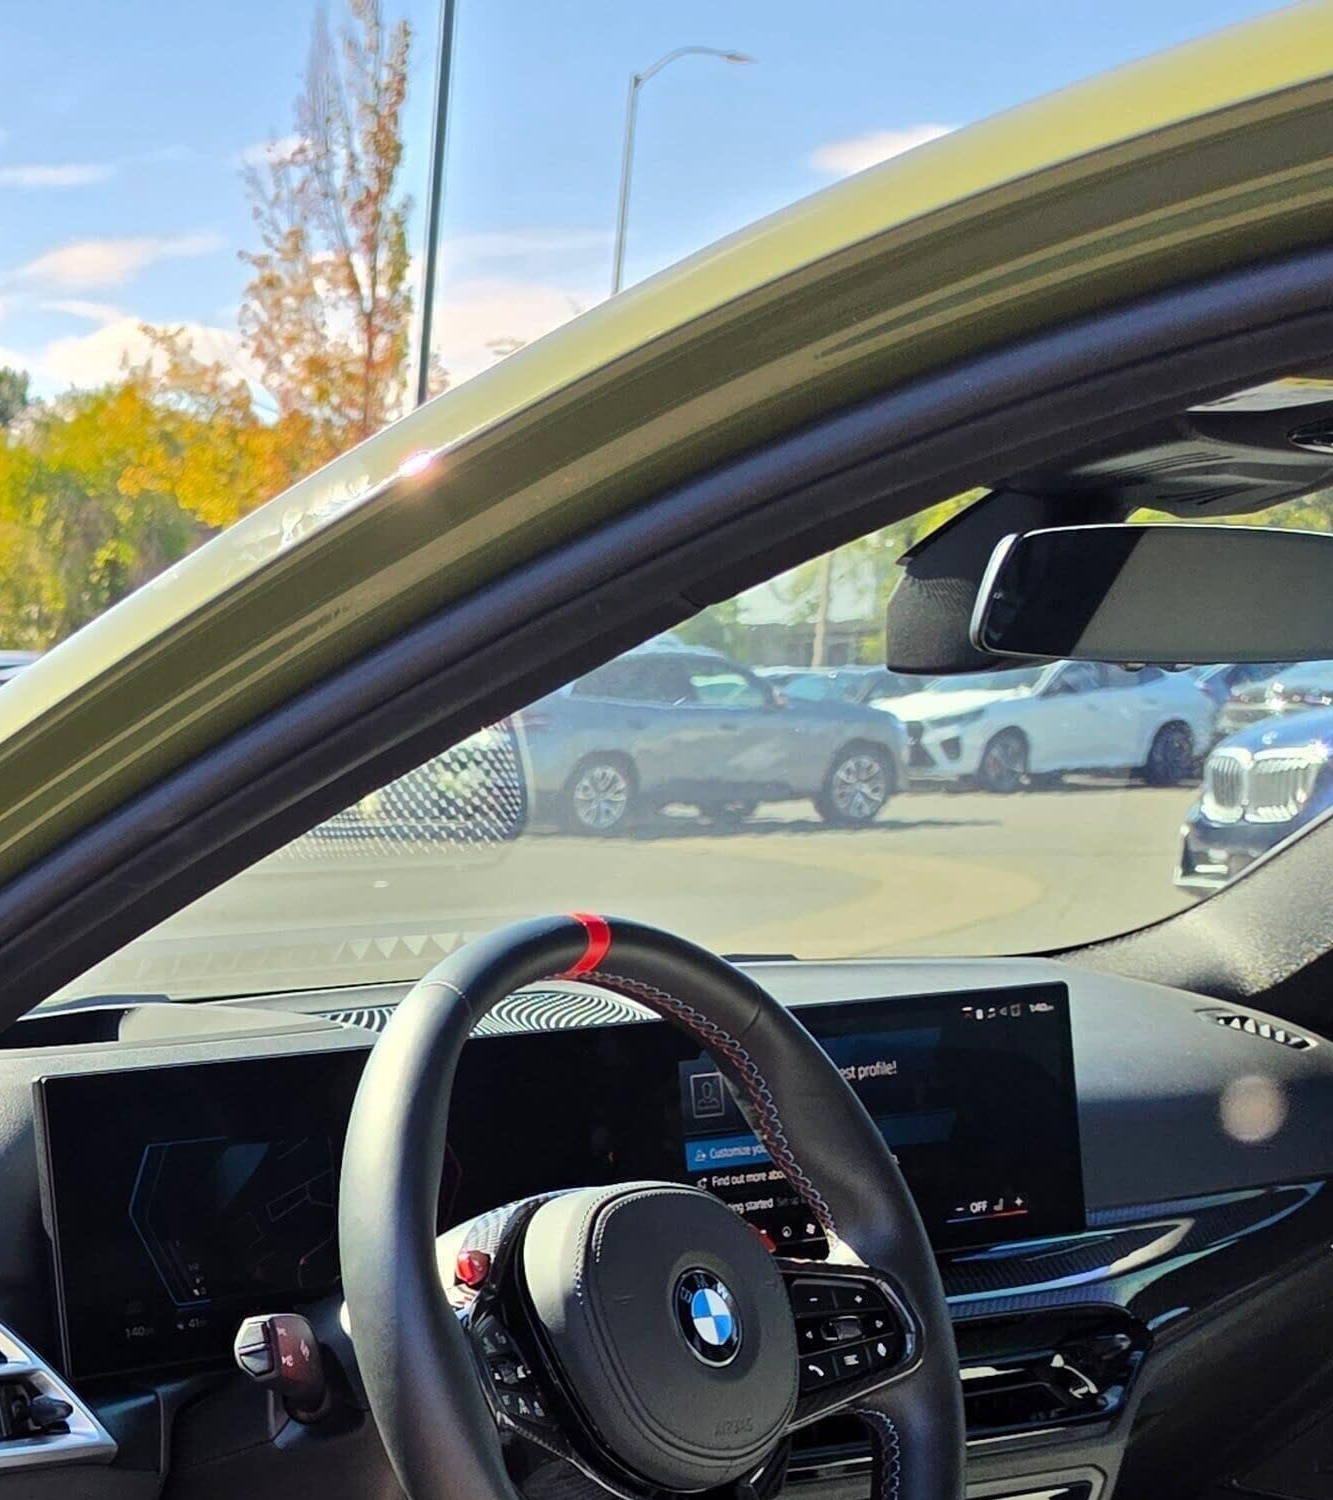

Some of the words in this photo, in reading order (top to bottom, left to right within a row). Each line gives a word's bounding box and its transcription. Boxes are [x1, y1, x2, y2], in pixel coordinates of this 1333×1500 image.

[858, 1060, 897, 1081] profile!
[710, 1146, 751, 1159] Customize
[712, 1175, 730, 1187] Find
[731, 1174, 745, 1185] out
[746, 1172, 767, 1182] more
[745, 1197, 774, 1211] started
[969, 1200, 987, 1213] OFF
